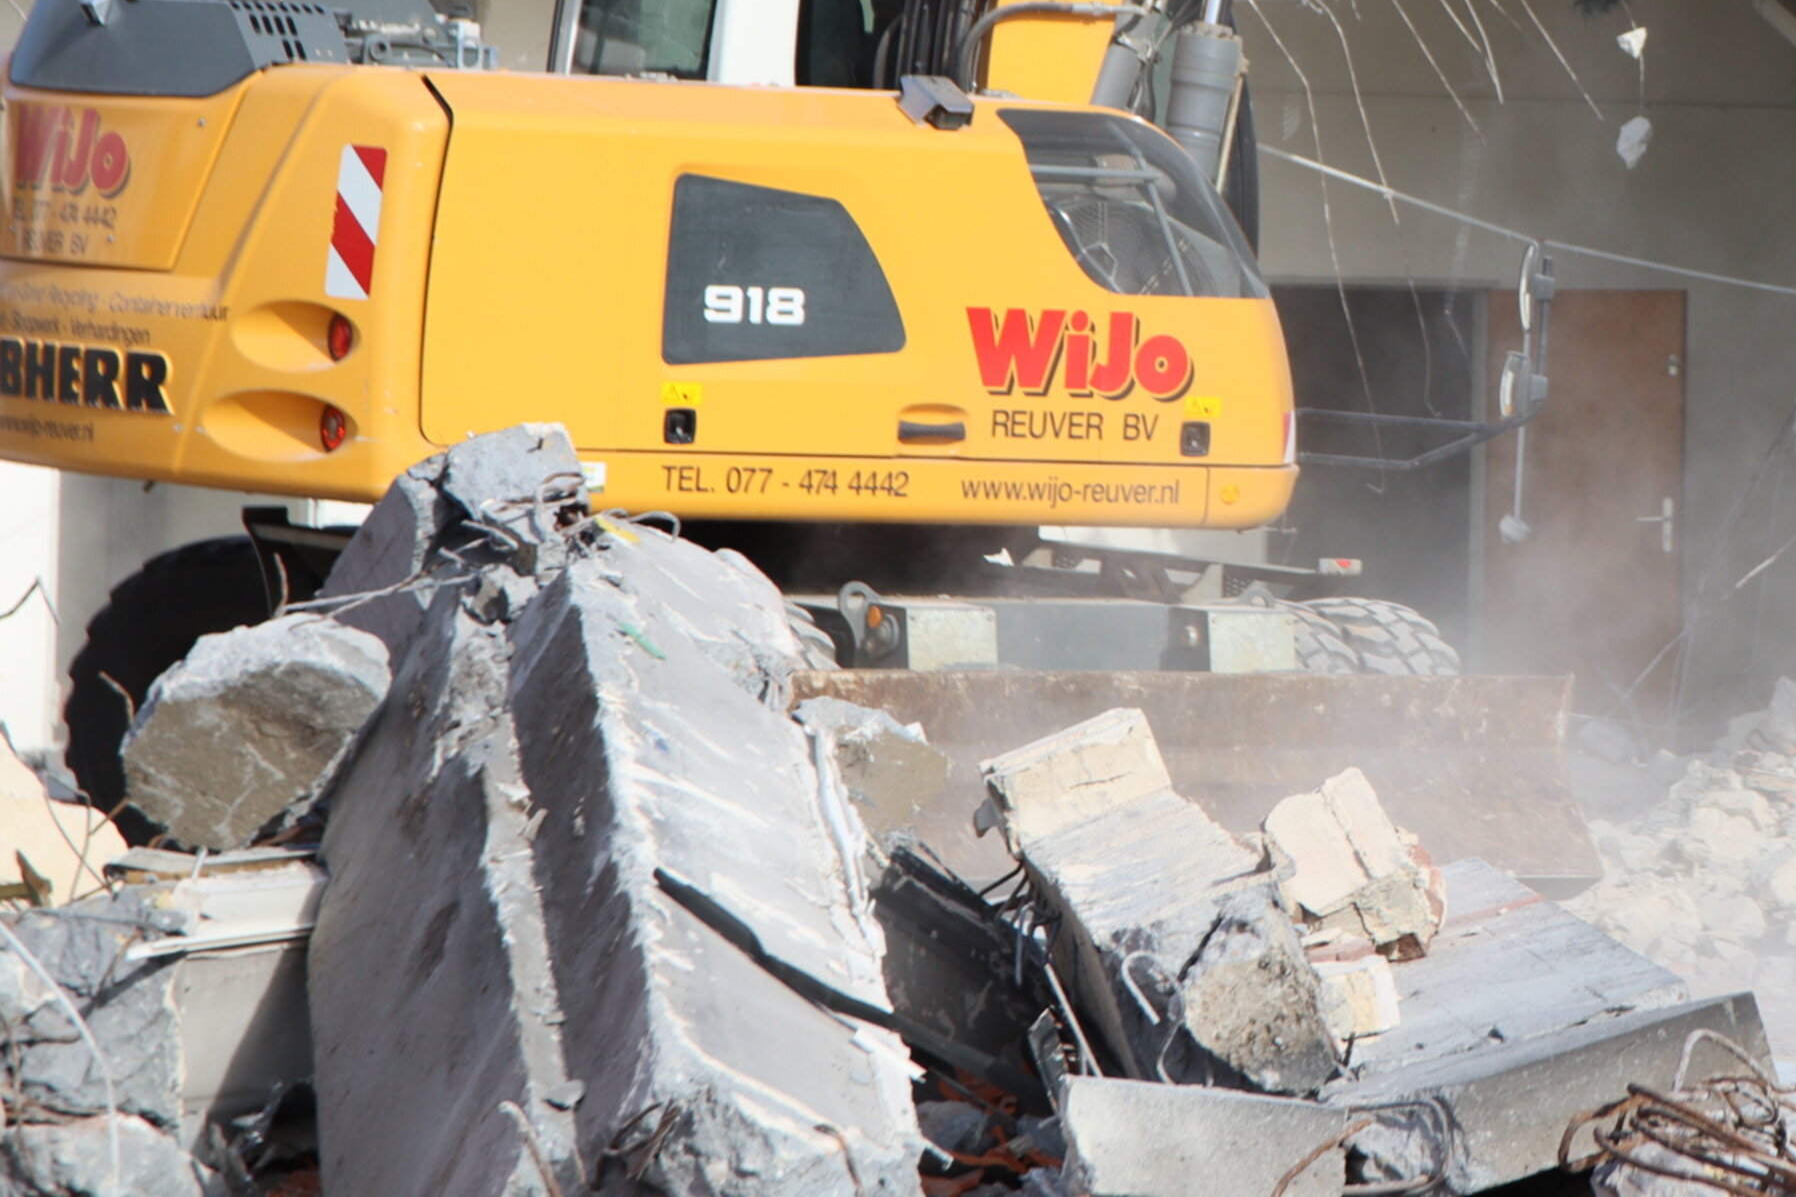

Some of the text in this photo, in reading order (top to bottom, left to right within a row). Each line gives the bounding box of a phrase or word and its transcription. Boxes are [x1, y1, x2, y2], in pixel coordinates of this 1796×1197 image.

[16, 104, 131, 198] WiJo
[704, 285, 805, 325] 918
[966, 306, 1194, 402] WiJo
[991, 409, 1159, 440] REUVER BV
[661, 465, 716, 493] TEL.
[726, 466, 773, 494] 077
[799, 468, 839, 495] 474
[848, 470, 910, 497] 4442
[961, 476, 1180, 509] www.wijo-reuver.nl
